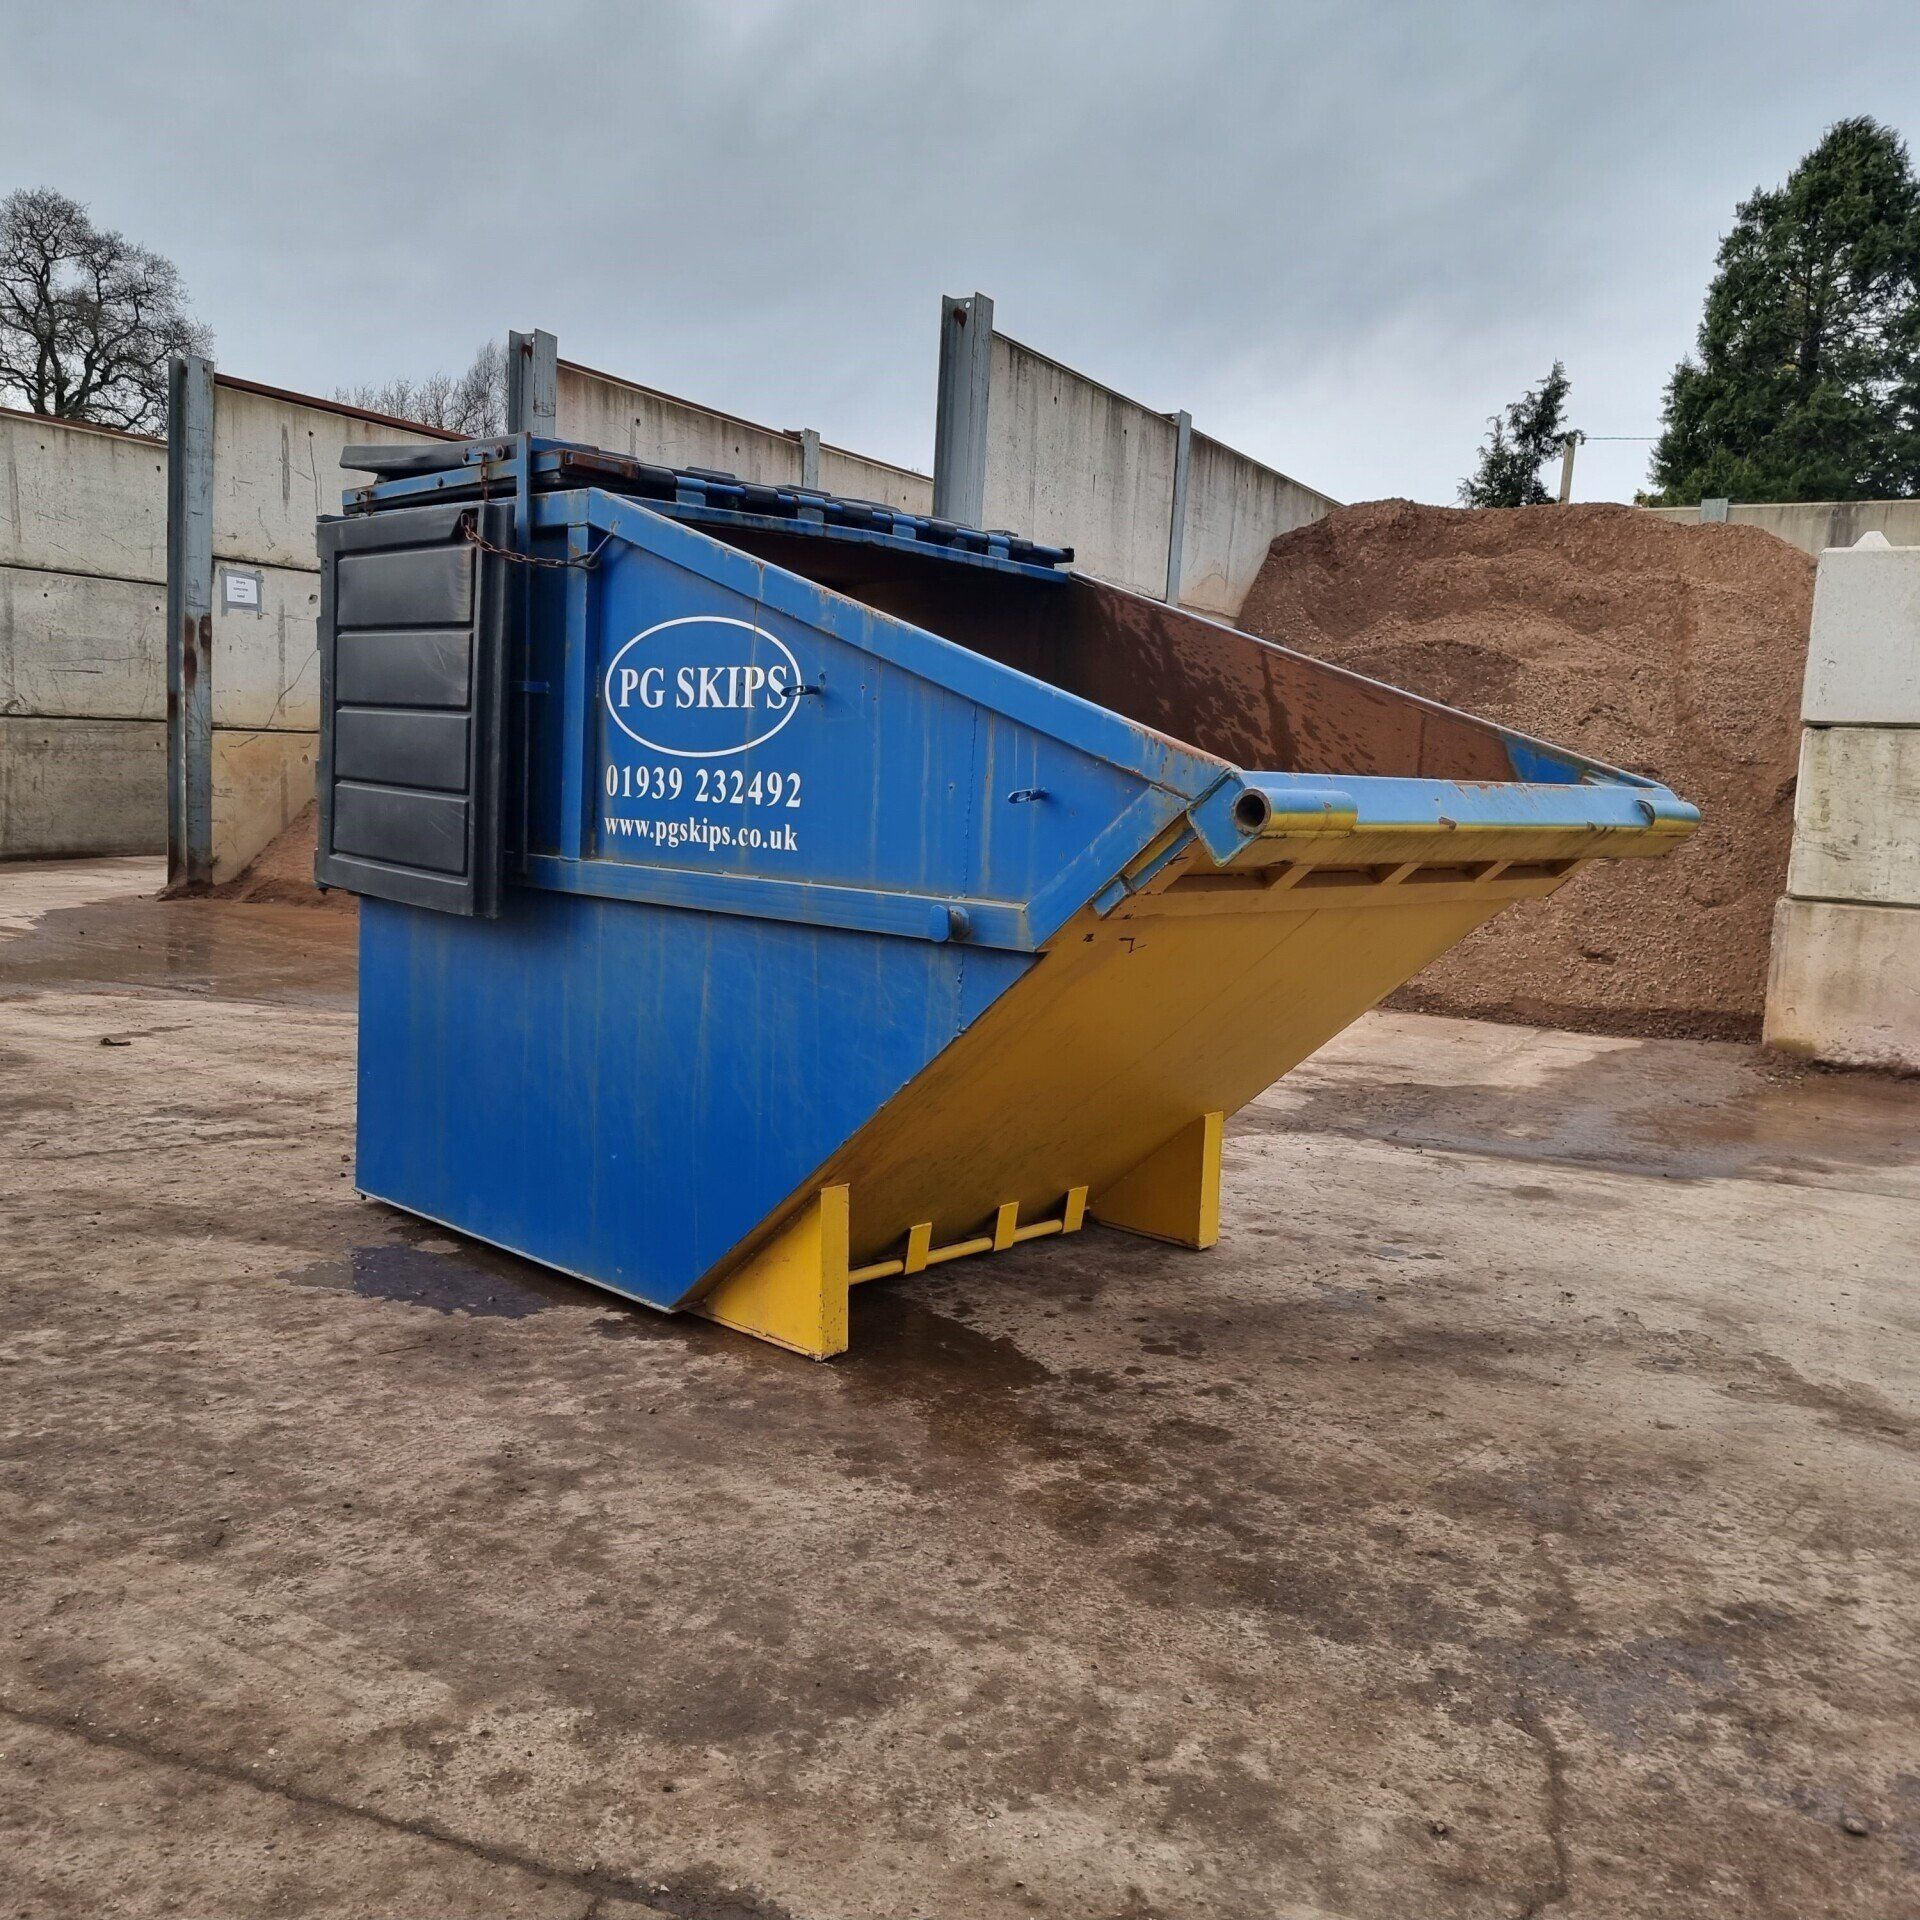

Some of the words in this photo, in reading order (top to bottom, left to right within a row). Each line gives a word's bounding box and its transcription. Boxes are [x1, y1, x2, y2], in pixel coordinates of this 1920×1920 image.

[618, 667, 666, 708] PG
[676, 665, 787, 710] SKIPS
[606, 765, 683, 800] 01939
[694, 768, 801, 808] 232492
[604, 816, 798, 851] www.pgskips.co.uk
